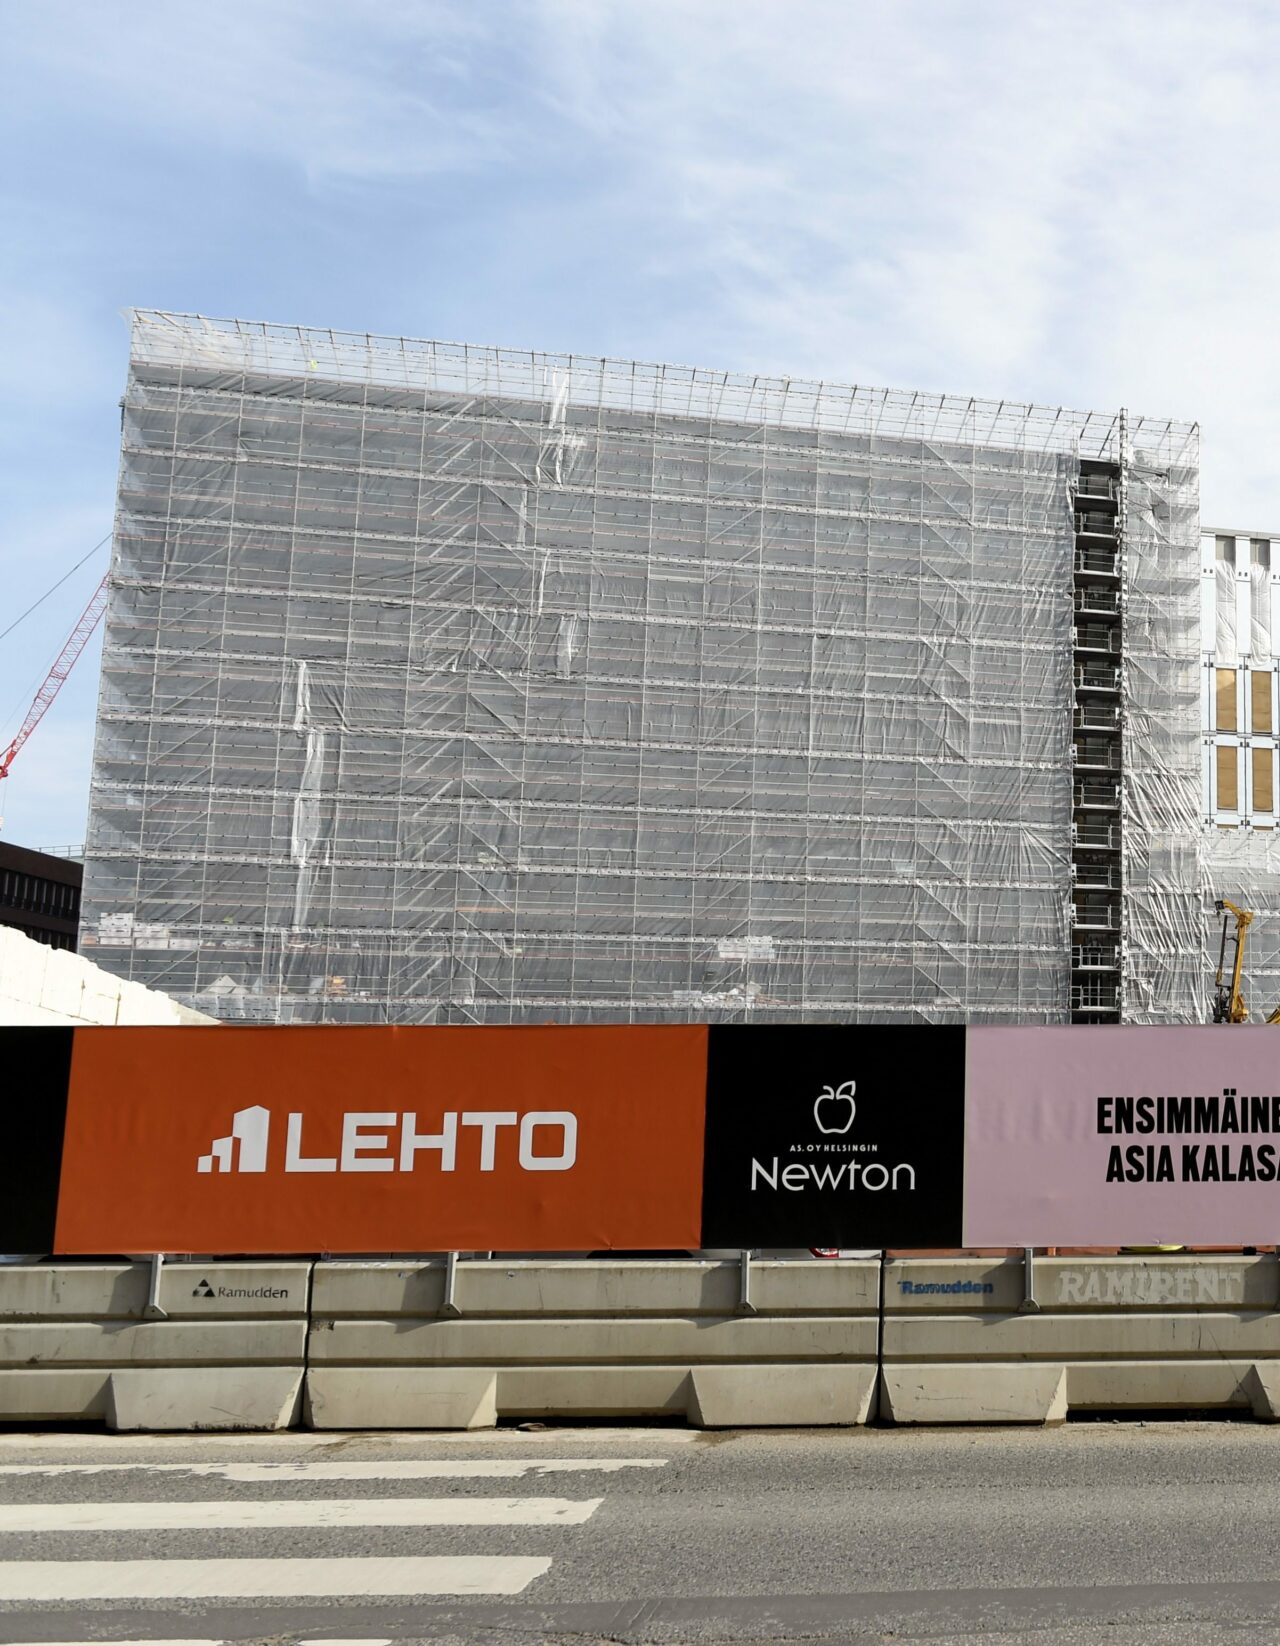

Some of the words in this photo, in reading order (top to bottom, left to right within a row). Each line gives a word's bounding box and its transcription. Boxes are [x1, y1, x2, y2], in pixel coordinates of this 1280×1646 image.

[285, 1111, 577, 1172] LEHTO
[790, 1144, 804, 1152] AS.
[807, 1144, 821, 1152] OY
[824, 1144, 878, 1152] HELSINGIN
[751, 1157, 916, 1191] Newton
[1106, 1144, 1175, 1183] ASIA
[218, 1286, 289, 1299] Ramudden
[900, 1279, 994, 1295] Ramudden
